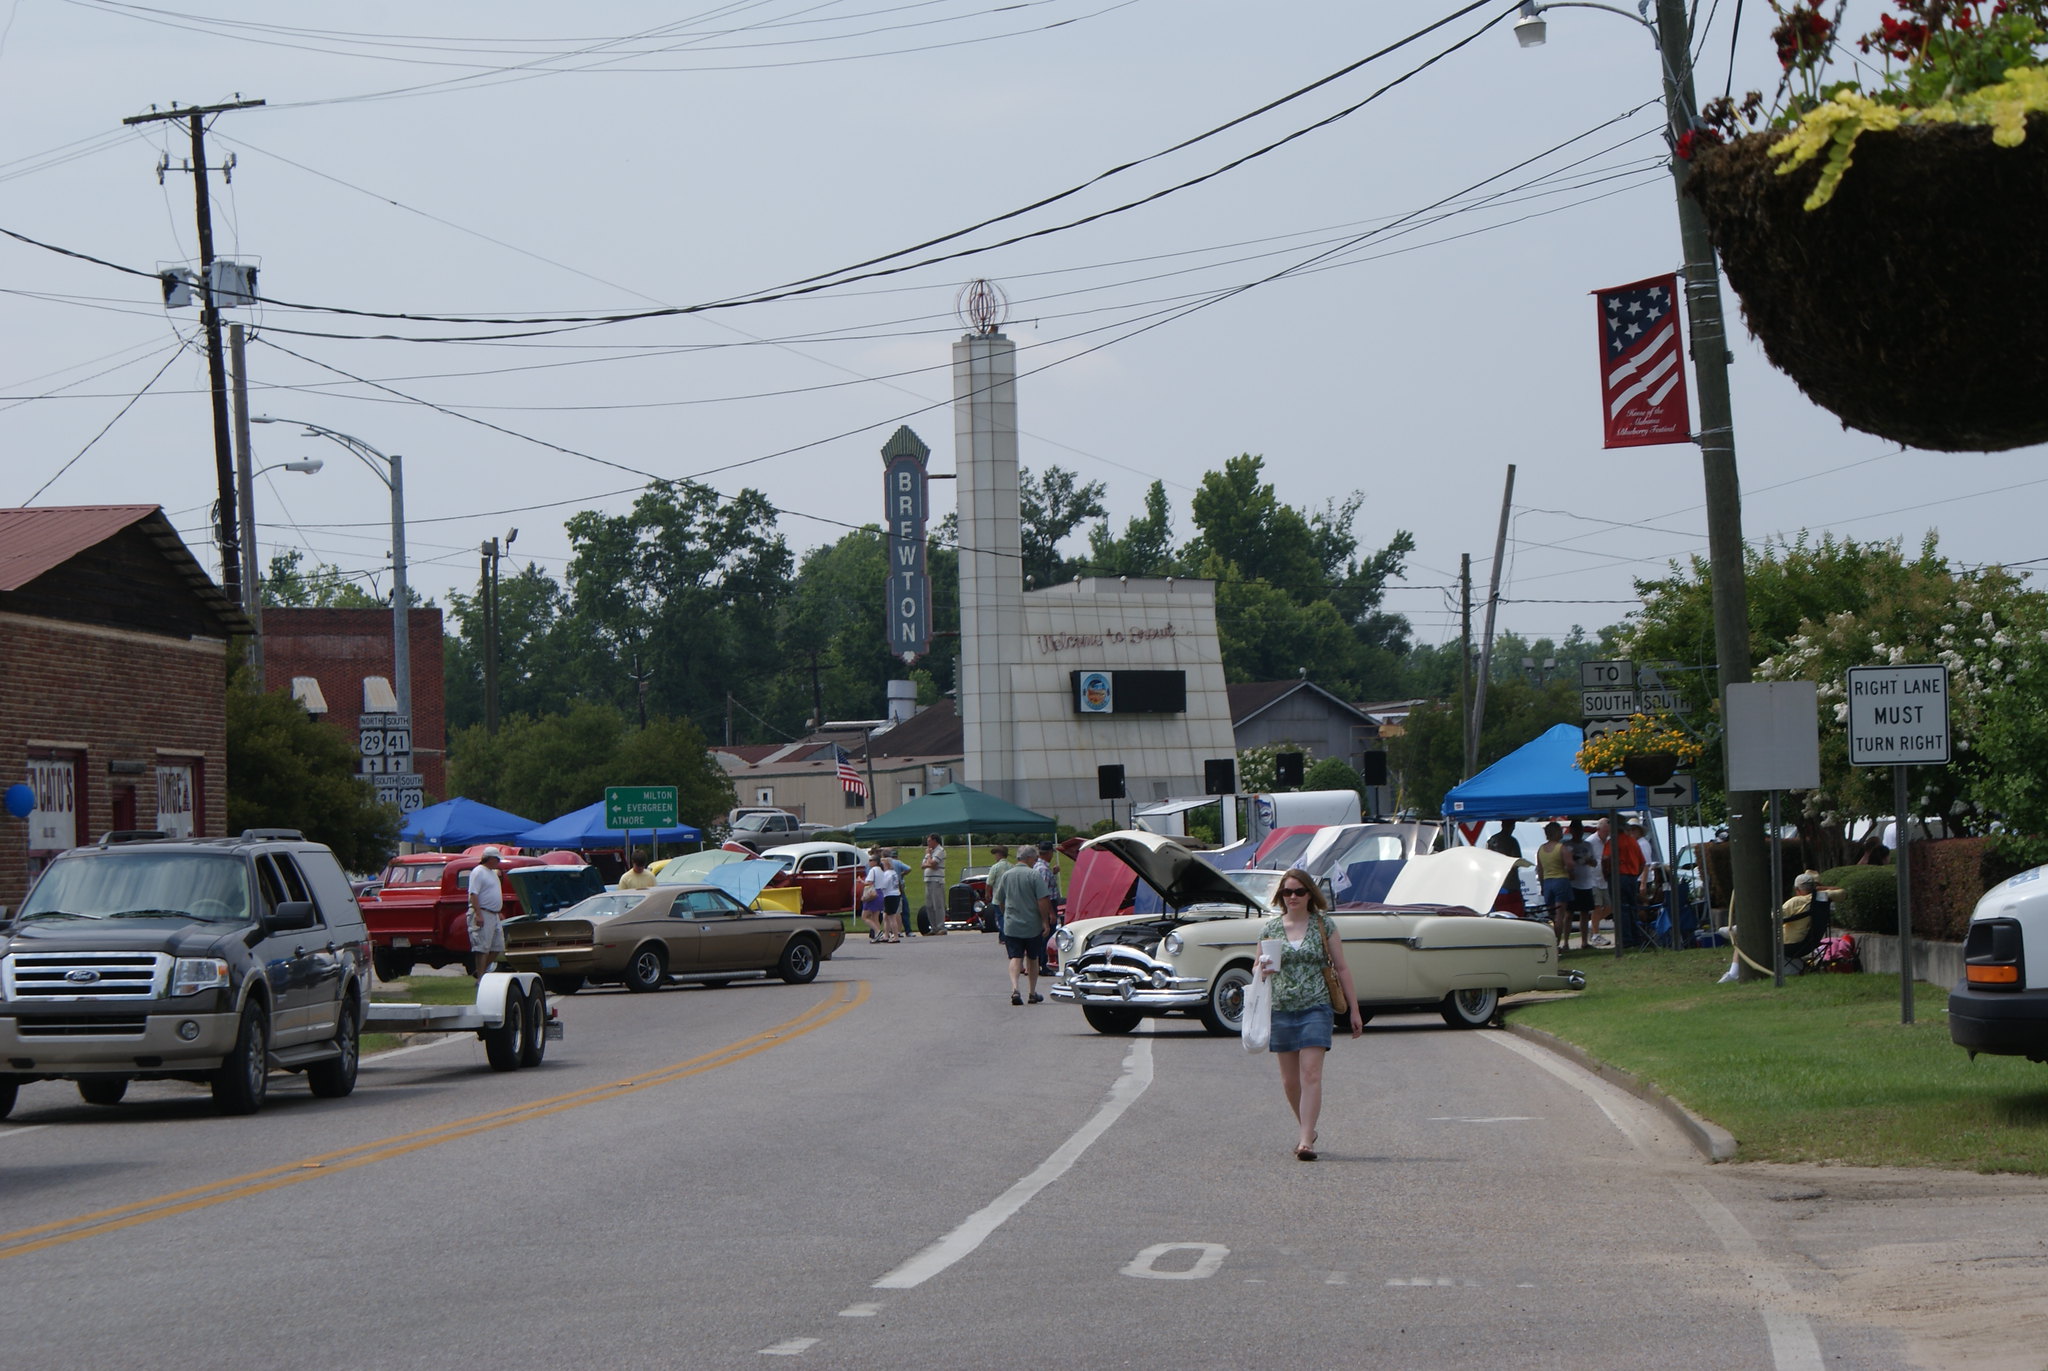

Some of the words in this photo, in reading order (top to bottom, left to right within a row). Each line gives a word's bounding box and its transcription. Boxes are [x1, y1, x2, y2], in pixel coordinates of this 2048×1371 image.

[897, 472, 916, 643] BREWTON
[1037, 632, 1104, 655] Welcome
[1106, 628, 1125, 644] to
[1594, 666, 1619, 681] TO
[1855, 680, 1897, 696] RIGHT
[1904, 679, 1941, 694] LANE
[1585, 696, 1631, 712] SOUTH
[1643, 695, 1690, 710] SOUTH
[361, 717, 383, 725] NORTH
[387, 717, 409, 726] SOUTH
[1874, 706, 1923, 725] MUST
[364, 735, 380, 750] 29
[388, 735, 404, 750] 41
[1856, 736, 1894, 751] TURN
[1900, 735, 1942, 750] RIGHT
[375, 776, 398, 785] SOUTH
[401, 776, 423, 786] SOUTH
[404, 793, 420, 809] 29
[643, 791, 672, 800] MILTON
[627, 803, 673, 812] EVERGREEN
[612, 816, 645, 825] ATMORE
